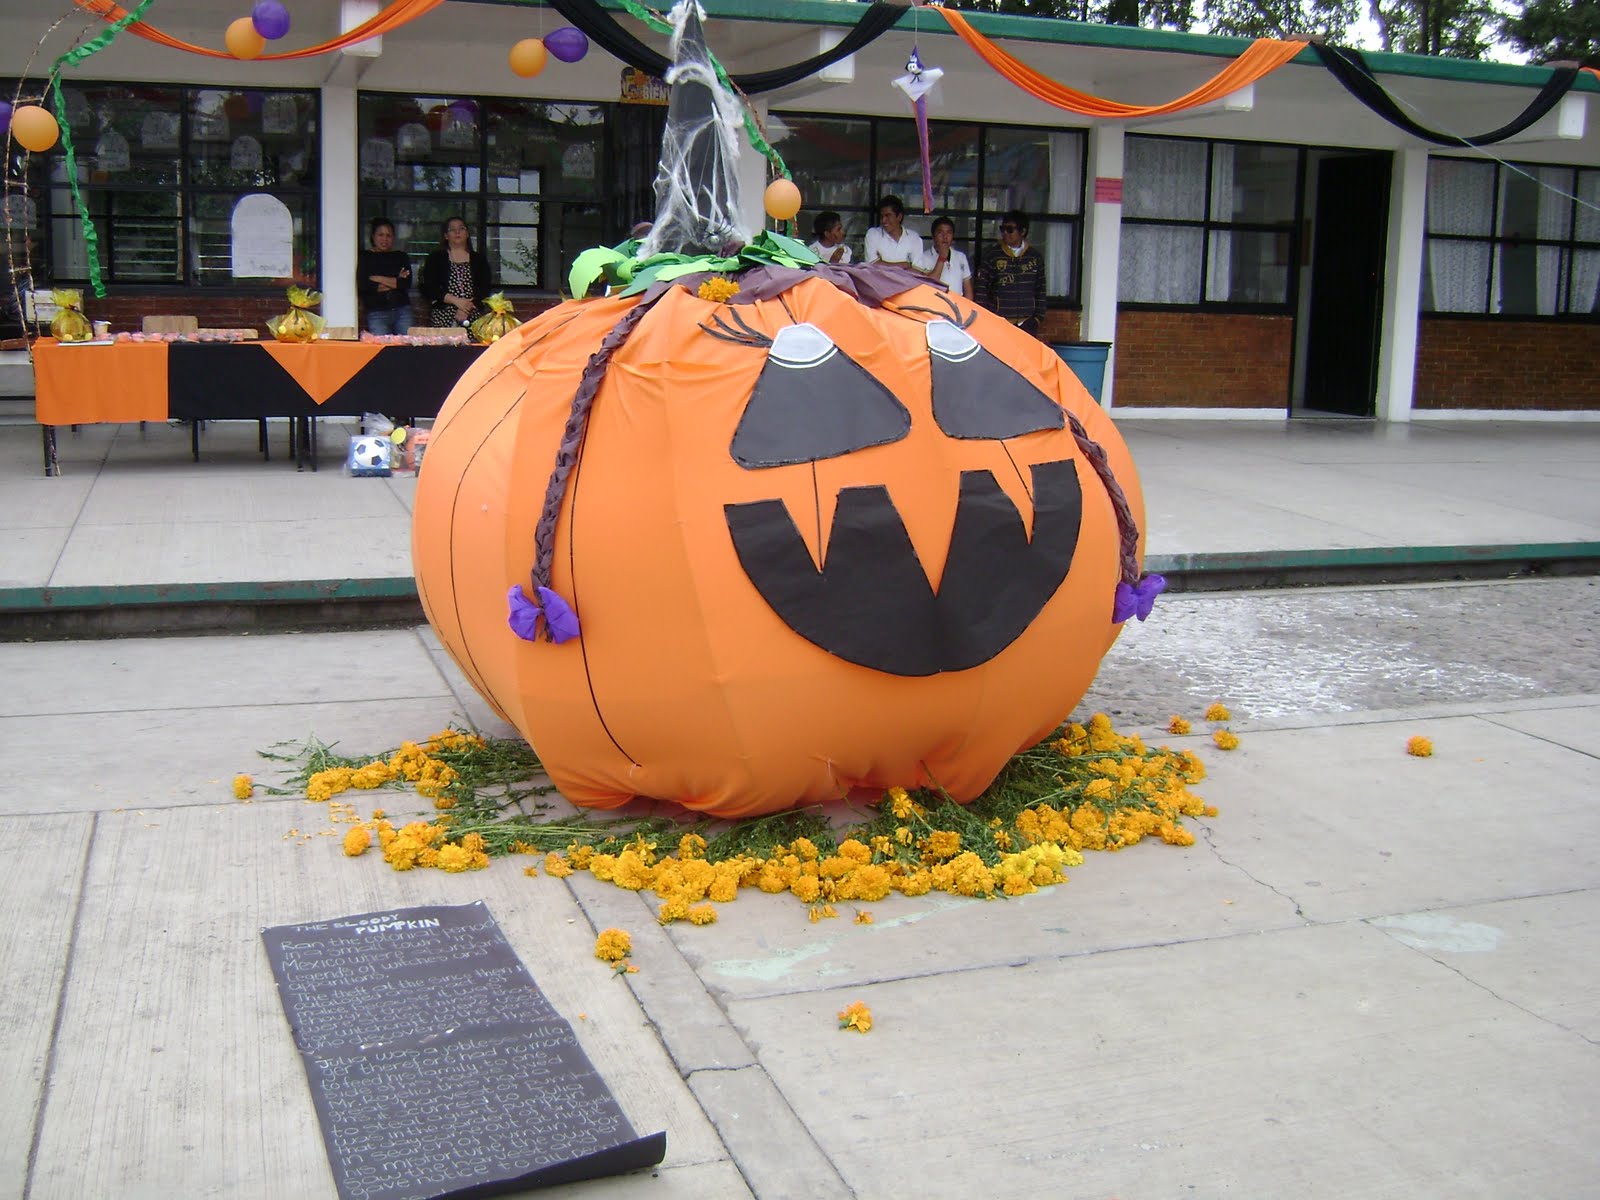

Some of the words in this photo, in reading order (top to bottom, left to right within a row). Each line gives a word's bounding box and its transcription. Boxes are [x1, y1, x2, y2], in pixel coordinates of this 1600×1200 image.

[293, 923, 329, 932] THE
[333, 913, 399, 929] BLOODY
[355, 918, 440, 934] PUMPKIN
[281, 941, 325, 951] Ran
[328, 935, 361, 946] the
[282, 959, 346, 971] Mexico
[348, 951, 404, 964] where
[358, 963, 376, 973] of
[290, 993, 328, 1005] The
[398, 980, 424, 989] the
[315, 1057, 367, 1070] Julia
[375, 1050, 420, 1061] was
[320, 1080, 341, 1091] to
[331, 1125, 360, 1140] to
